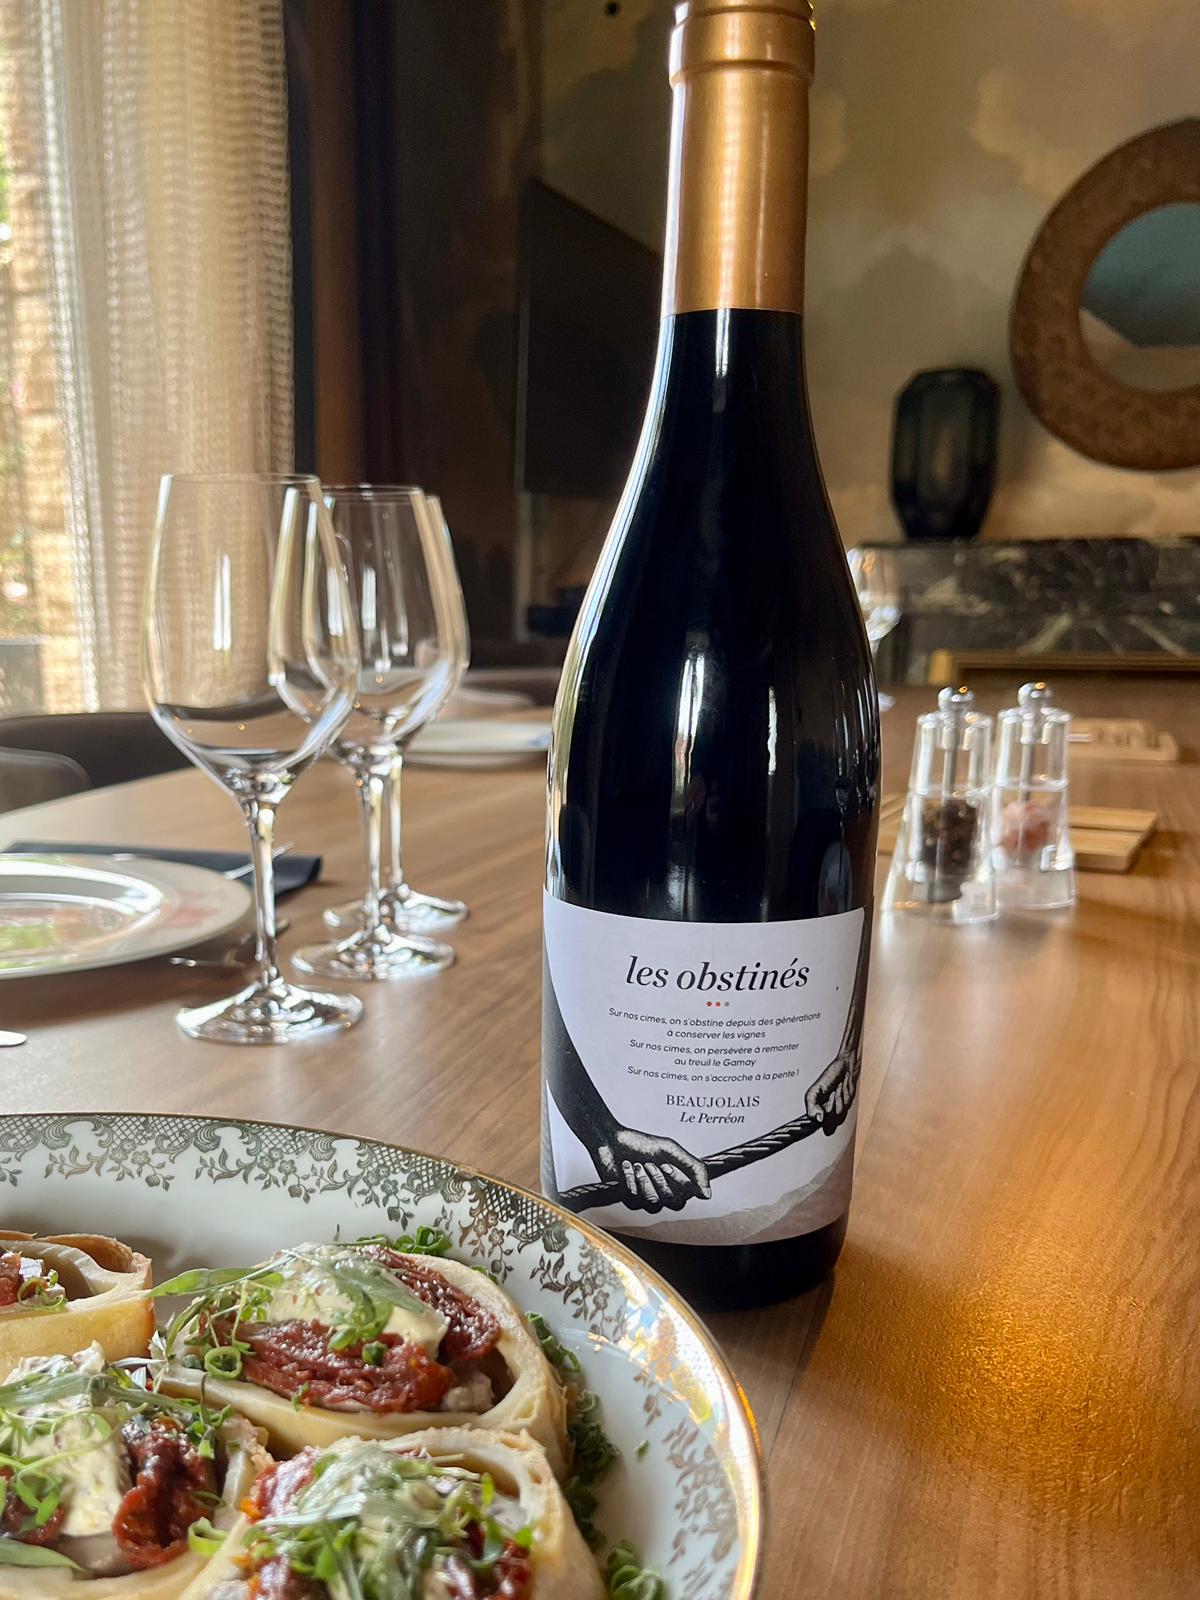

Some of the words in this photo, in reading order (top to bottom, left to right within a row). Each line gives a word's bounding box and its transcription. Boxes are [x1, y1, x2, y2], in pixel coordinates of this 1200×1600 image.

[626, 955, 669, 987] les
[676, 957, 810, 991] obstinés
[609, 1007, 622, 1017] Sur
[623, 1011, 638, 1020] nos
[640, 1014, 668, 1025] cimes,
[683, 1017, 724, 1027] s'obstine
[725, 1018, 756, 1028] depuis
[758, 1016, 774, 1026] des
[775, 1012, 821, 1025] générations
[675, 1030, 720, 1039] conserver
[722, 1031, 735, 1039] les
[737, 1030, 766, 1040] vignes
[630, 1039, 644, 1049] Sur
[646, 1043, 662, 1051] nos
[663, 1044, 692, 1054] cimes,
[708, 1046, 752, 1056] persévère
[762, 1043, 800, 1053] remonter
[674, 1058, 686, 1066] au
[688, 1058, 711, 1067] treuil
[712, 1059, 721, 1067] le
[723, 1059, 756, 1067] Gamay
[628, 1066, 642, 1075] Sur
[643, 1069, 659, 1078] nos
[661, 1072, 689, 1082] cimes,
[705, 1074, 753, 1082] s'accroche
[762, 1072, 771, 1081] la
[666, 1095, 760, 1108] BEAUJOLAIS
[680, 1112, 696, 1124] Le
[698, 1112, 745, 1124] Perréon
